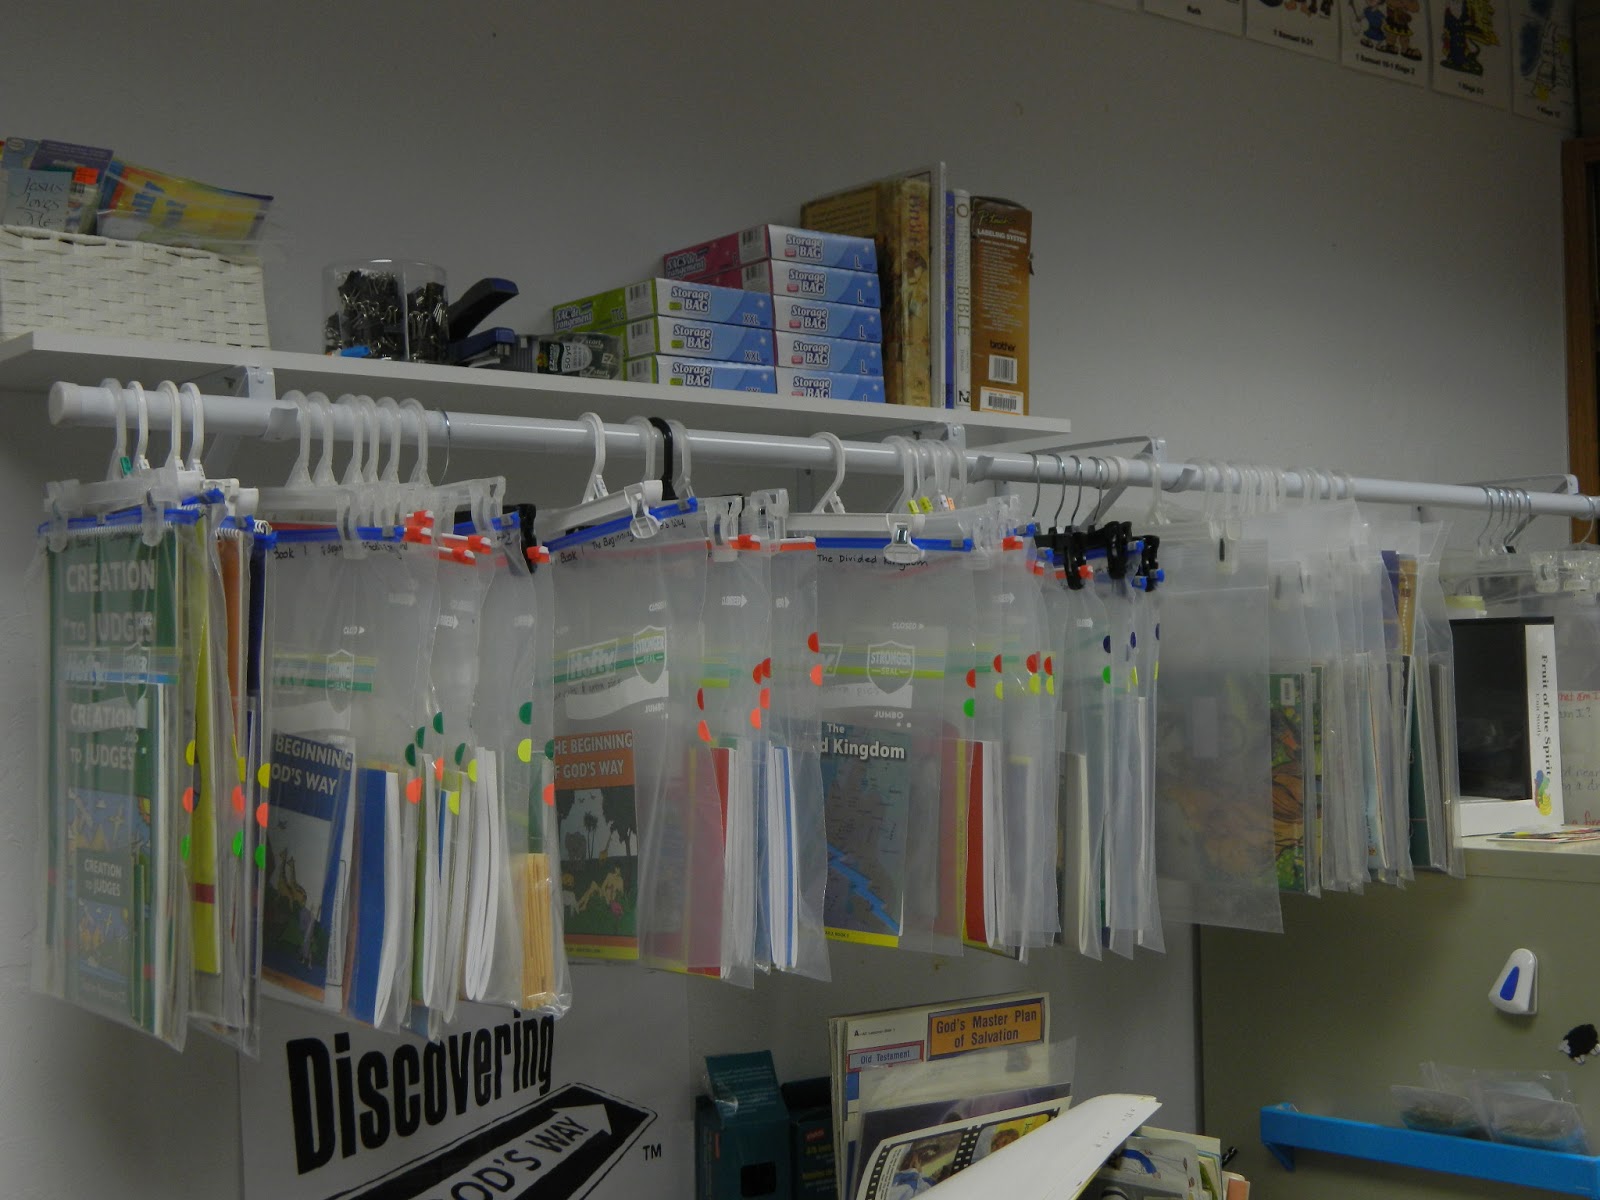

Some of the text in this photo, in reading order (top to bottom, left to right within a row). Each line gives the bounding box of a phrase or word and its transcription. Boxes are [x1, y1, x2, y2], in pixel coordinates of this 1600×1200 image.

[24, 177, 64, 194] Jesus
[786, 234, 822, 248] Storage
[977, 228, 1006, 240] LABELING
[1006, 233, 1027, 244] SYSTEM
[799, 246, 822, 259] BAG
[854, 256, 861, 269] L
[789, 269, 825, 283] Storage
[671, 286, 710, 300] Storage
[802, 280, 825, 294] BAG
[857, 289, 864, 303] L
[684, 298, 709, 312] BAG
[791, 305, 828, 318] Storage
[957, 286, 970, 336] BIBLE
[555, 312, 593, 330] rangement
[743, 313, 760, 326] XXL
[804, 316, 827, 330] BAG
[673, 324, 712, 338] Storage
[859, 325, 866, 339] L
[686, 336, 711, 350] BAG
[793, 341, 830, 354] Storage
[989, 340, 1016, 352] brother
[601, 353, 614, 364] EZ
[744, 350, 761, 363] XXL
[805, 352, 829, 365] BAG
[672, 363, 712, 377] Storage
[860, 359, 867, 374] L
[686, 375, 711, 388] BAG
[793, 376, 831, 389] Storage
[806, 387, 830, 399] BAG
[958, 390, 970, 404] 2
[560, 551, 578, 564] Book
[817, 555, 833, 563] The
[839, 555, 878, 563] Divided
[66, 559, 155, 592] CREATION
[92, 611, 154, 642] JUDGES
[871, 651, 912, 666] STRONGER
[880, 667, 899, 676] SEAL
[70, 703, 136, 729] CREATION
[873, 710, 904, 719] JUMBO
[1541, 655, 1553, 775] Fruit of the Spirit
[827, 724, 845, 734] The
[554, 732, 633, 755] HE BEGINNING
[833, 738, 905, 760] Kingdom
[85, 743, 135, 771] JUDGES
[275, 735, 352, 771] BEGINNING
[563, 761, 596, 779] GOD'S
[599, 759, 624, 776] WAY
[271, 763, 338, 796] OD'S WAY
[84, 858, 122, 879] CREATION
[93, 880, 121, 897] JUDGES
[936, 1009, 1037, 1035] God's Master Plan
[954, 1028, 1019, 1048] of Salvation
[861, 1049, 910, 1065] Old Testament
[286, 1009, 555, 1175] Discovering
[448, 1116, 589, 1200] OD'S WAY
[642, 1143, 663, 1161] TM
